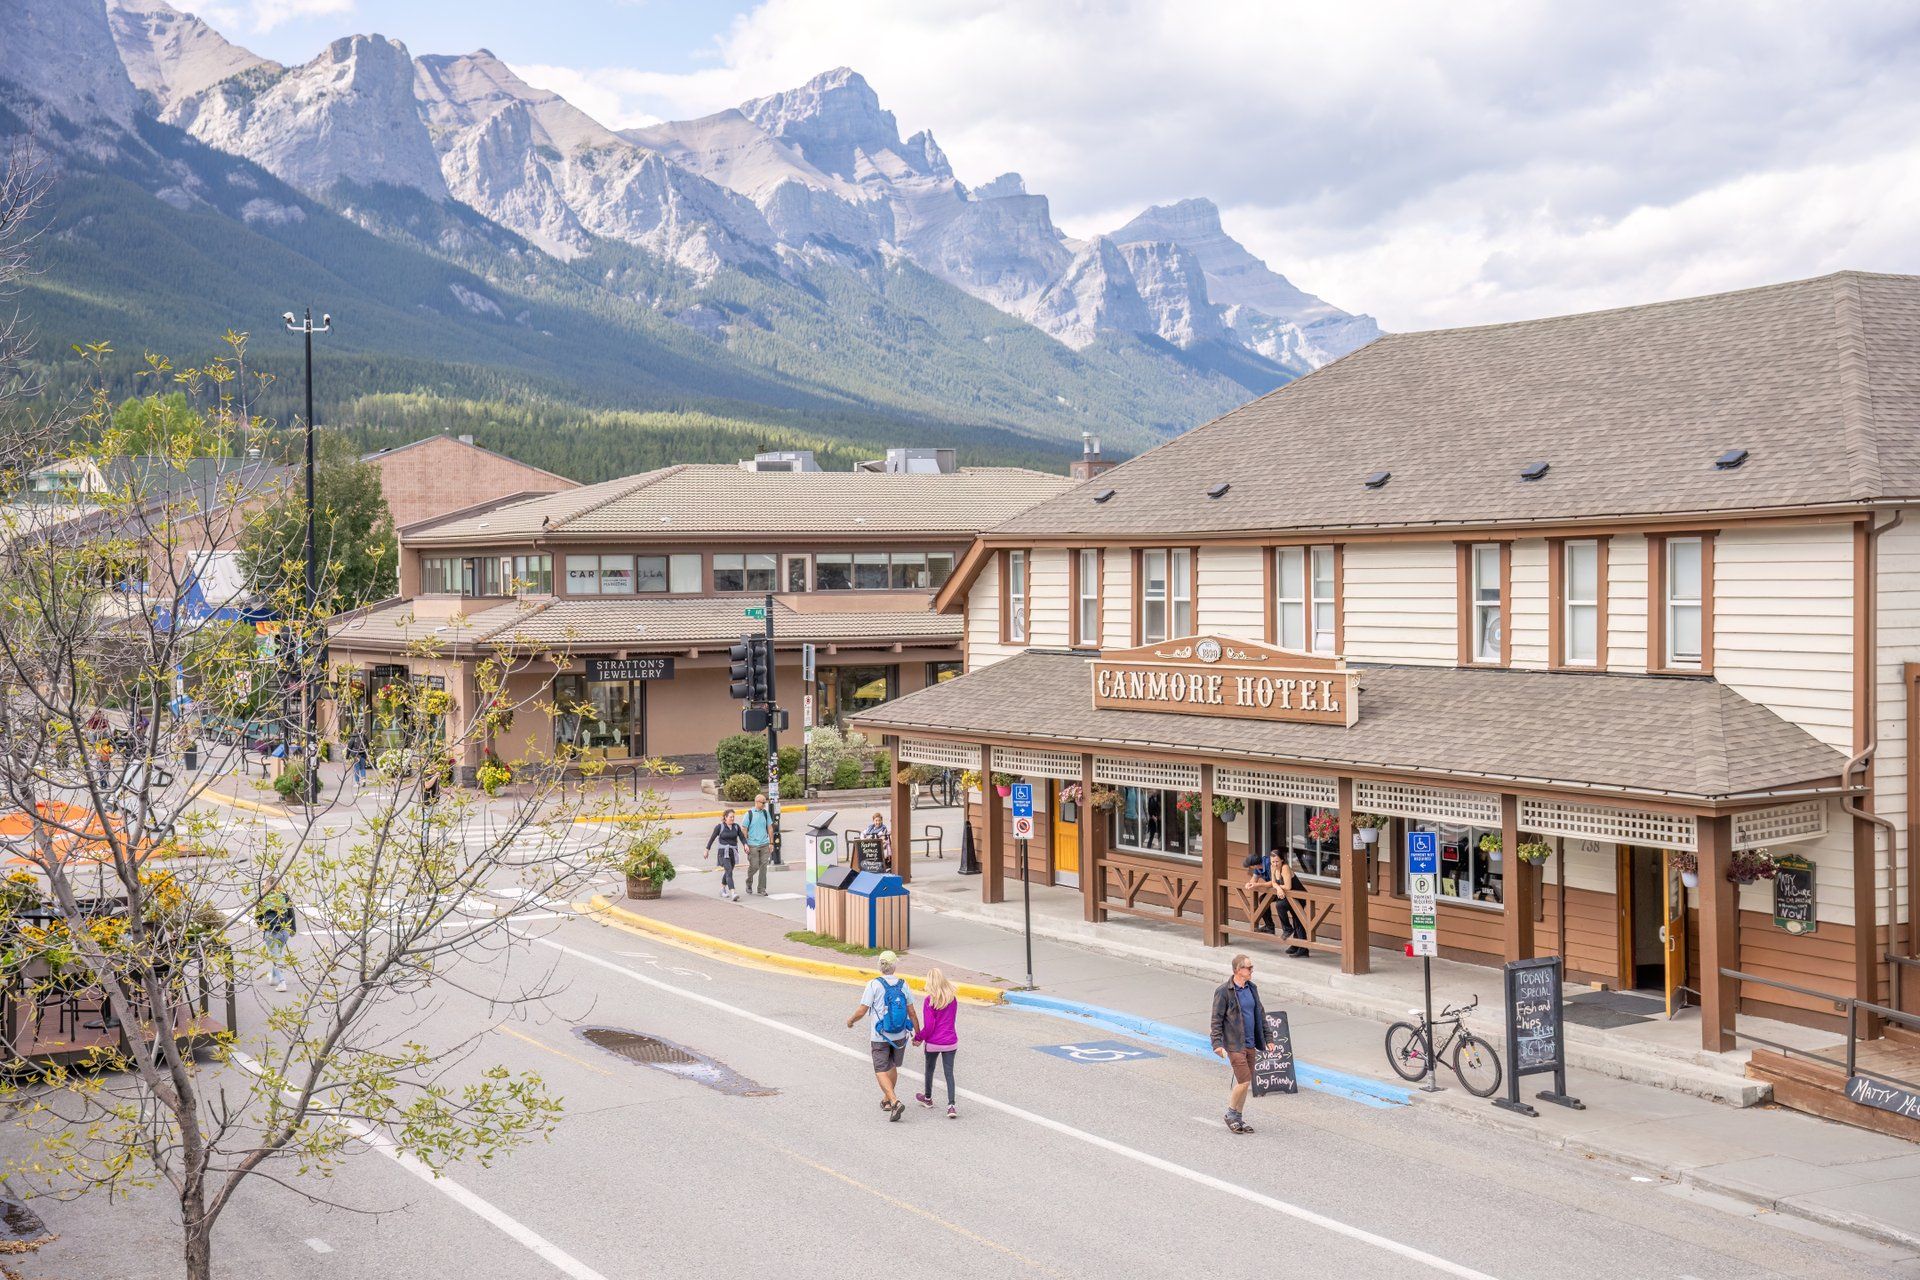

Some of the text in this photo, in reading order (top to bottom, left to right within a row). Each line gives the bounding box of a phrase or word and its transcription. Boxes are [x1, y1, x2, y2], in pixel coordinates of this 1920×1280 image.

[596, 659, 665, 670] STRATTON'S
[600, 669, 662, 680] JEWELLERY
[1097, 669, 1340, 712] CANMORE HOTEL
[1780, 908, 1807, 920] NOW!
[1520, 986, 1551, 999] SPECIAL
[1515, 1000, 1550, 1016] Fish and
[1255, 1075, 1269, 1090] Dog
[1851, 1079, 1899, 1103] MATTY
